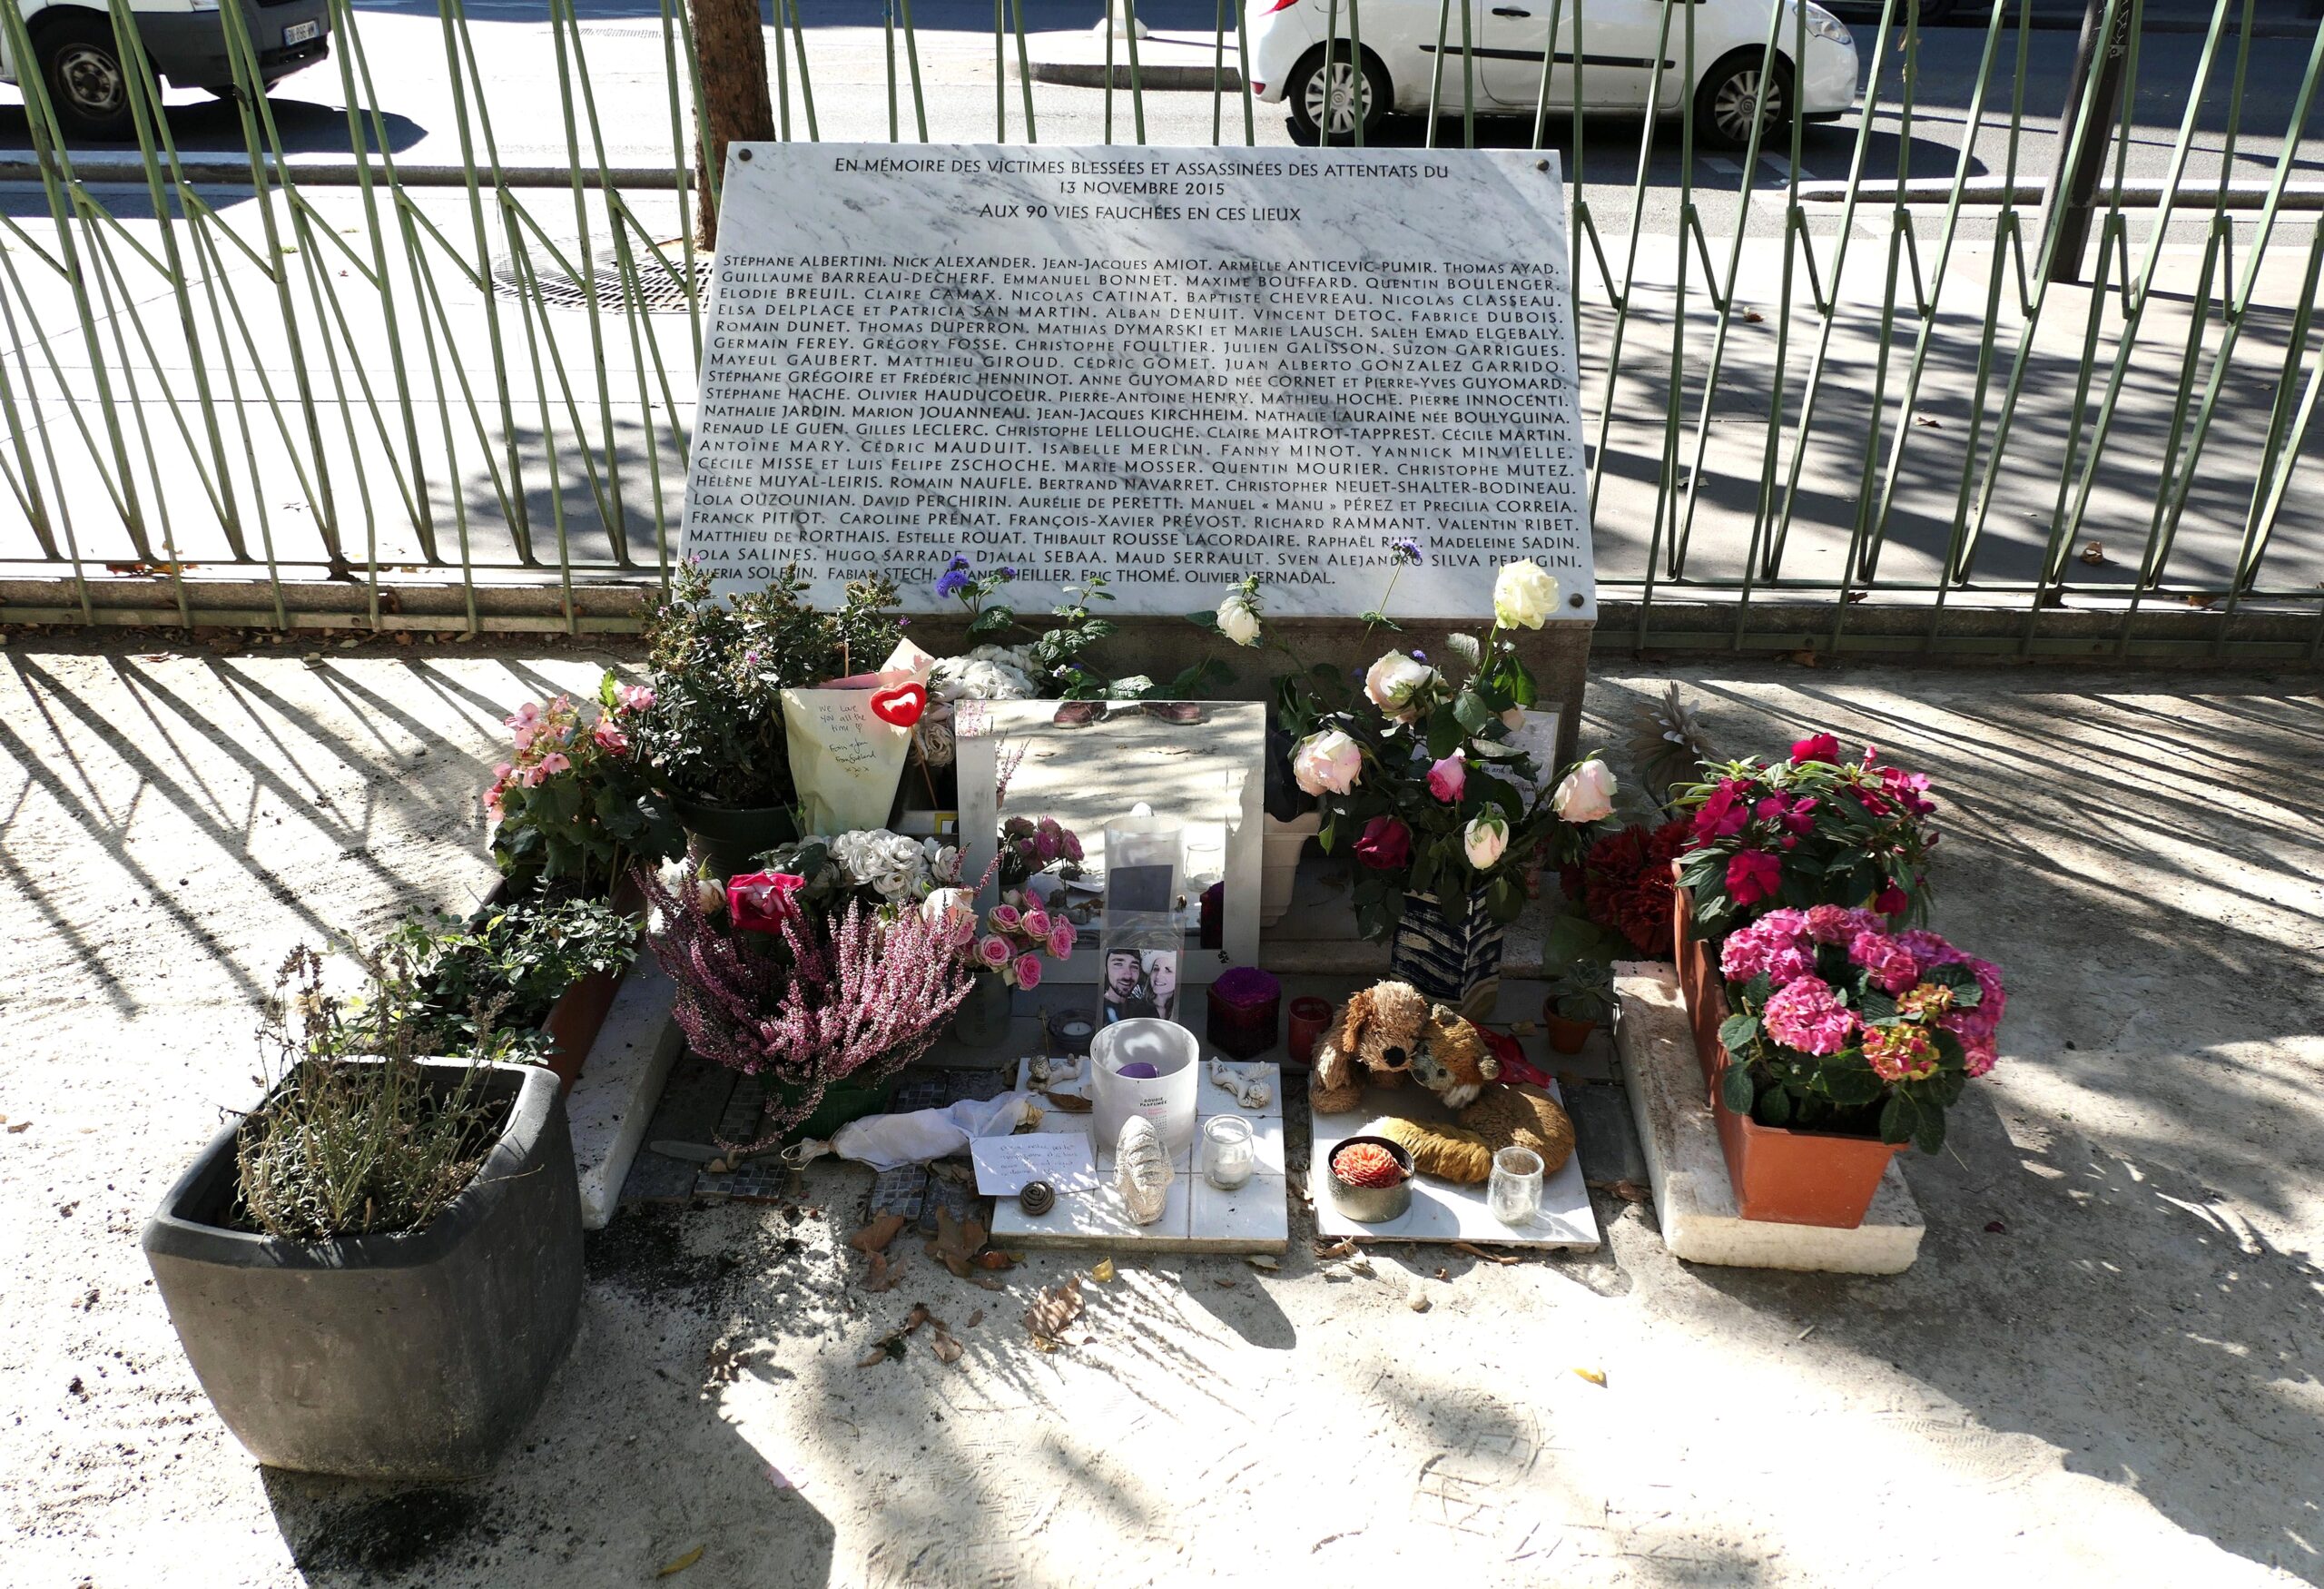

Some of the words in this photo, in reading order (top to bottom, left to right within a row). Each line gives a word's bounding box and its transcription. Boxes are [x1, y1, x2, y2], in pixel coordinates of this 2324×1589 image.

[834, 158, 857, 172] EN
[864, 155, 944, 173] MÉMOIRE
[951, 159, 980, 173] DES
[987, 160, 1065, 174] VICTIMES
[1071, 158, 1144, 175] BLESSÉES
[1151, 162, 1169, 175] ET
[1175, 160, 1282, 176] ASSASSINÉES
[1288, 163, 1318, 177] DES
[1324, 163, 1418, 178] ATTENTATS
[1423, 164, 1449, 178] DU
[1060, 181, 1076, 194] 13
[1083, 181, 1178, 195] NOVEMBRE
[1185, 182, 1225, 195] 2015
[979, 204, 1019, 218] AUX
[1026, 205, 1048, 218] 90
[1053, 205, 1088, 218] VIES
[1095, 202, 1181, 220] FAUCHÉES
[1187, 206, 1209, 220] EN
[1216, 206, 1246, 221] CES
[1252, 207, 1300, 222] LIEUX
